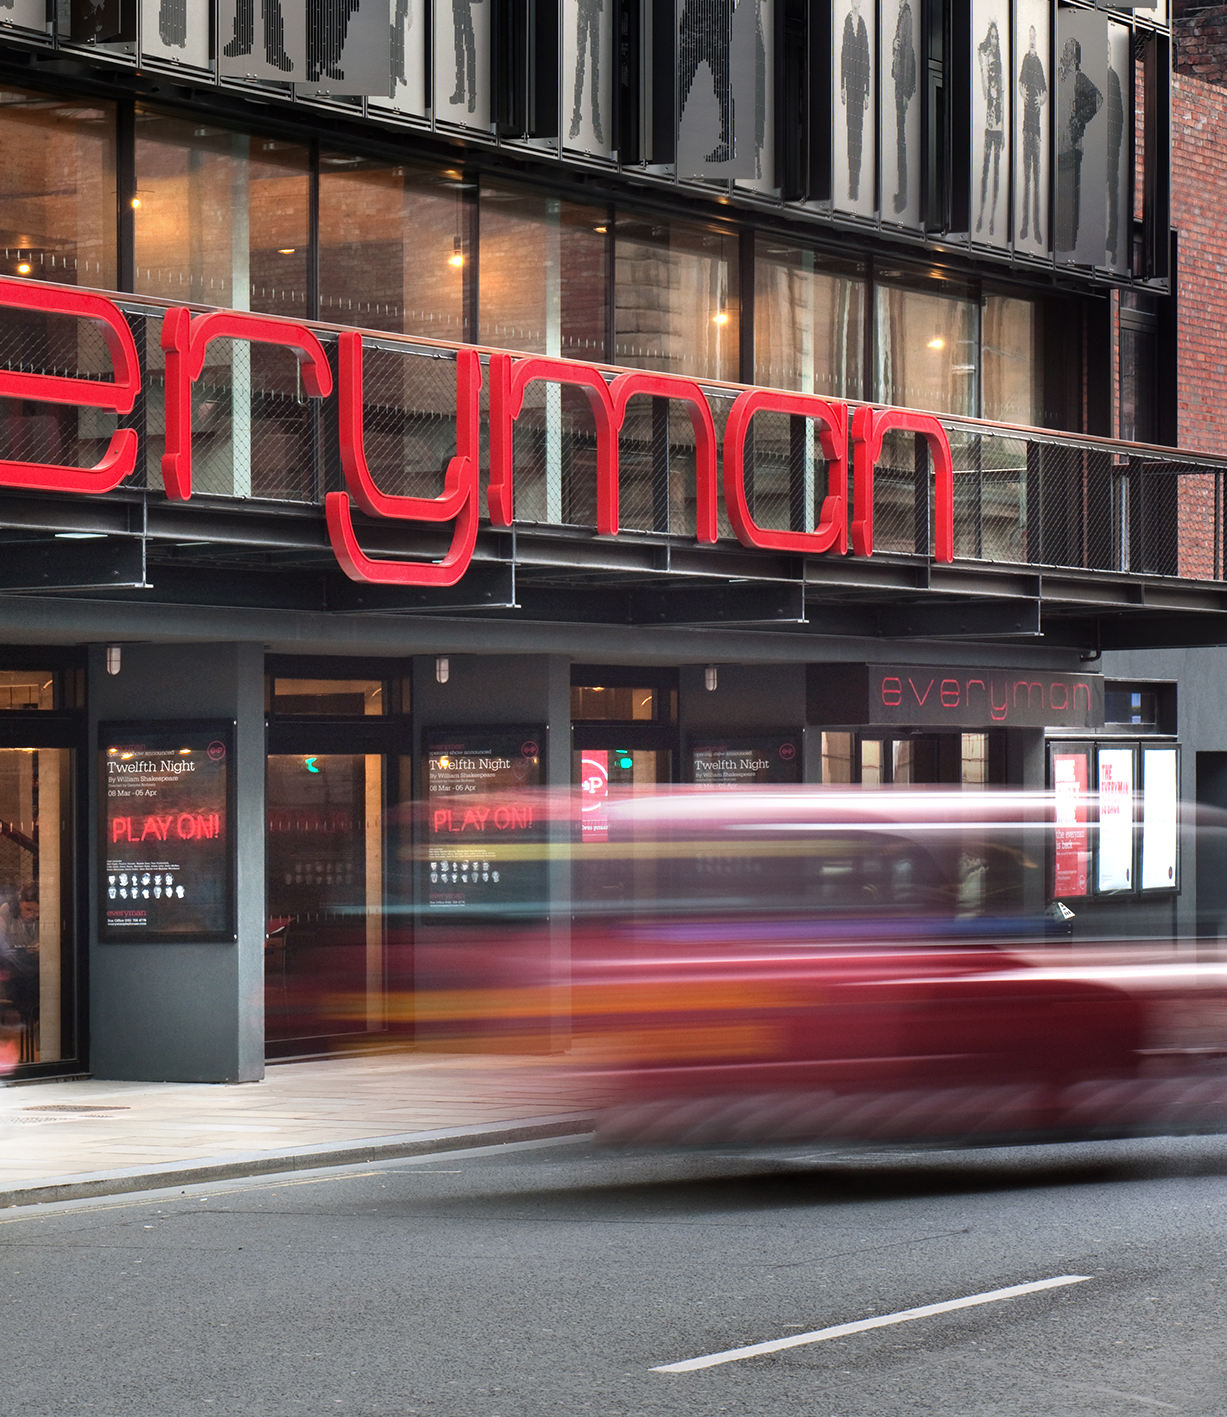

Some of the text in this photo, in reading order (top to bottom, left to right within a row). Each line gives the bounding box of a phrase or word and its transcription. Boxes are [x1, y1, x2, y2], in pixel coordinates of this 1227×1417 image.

[881, 677, 1090, 720] everyman
[107, 760, 195, 774] Twelfth Night
[479, 758, 511, 771] Night
[694, 759, 770, 771] Twelfth Night
[1102, 764, 1112, 780] THE
[140, 775, 178, 783] Shakespeare
[145, 789, 157, 797] Apr
[434, 807, 533, 833] PLAY ON!
[113, 812, 219, 843] PLAY ON!
[1056, 829, 1064, 839] the
